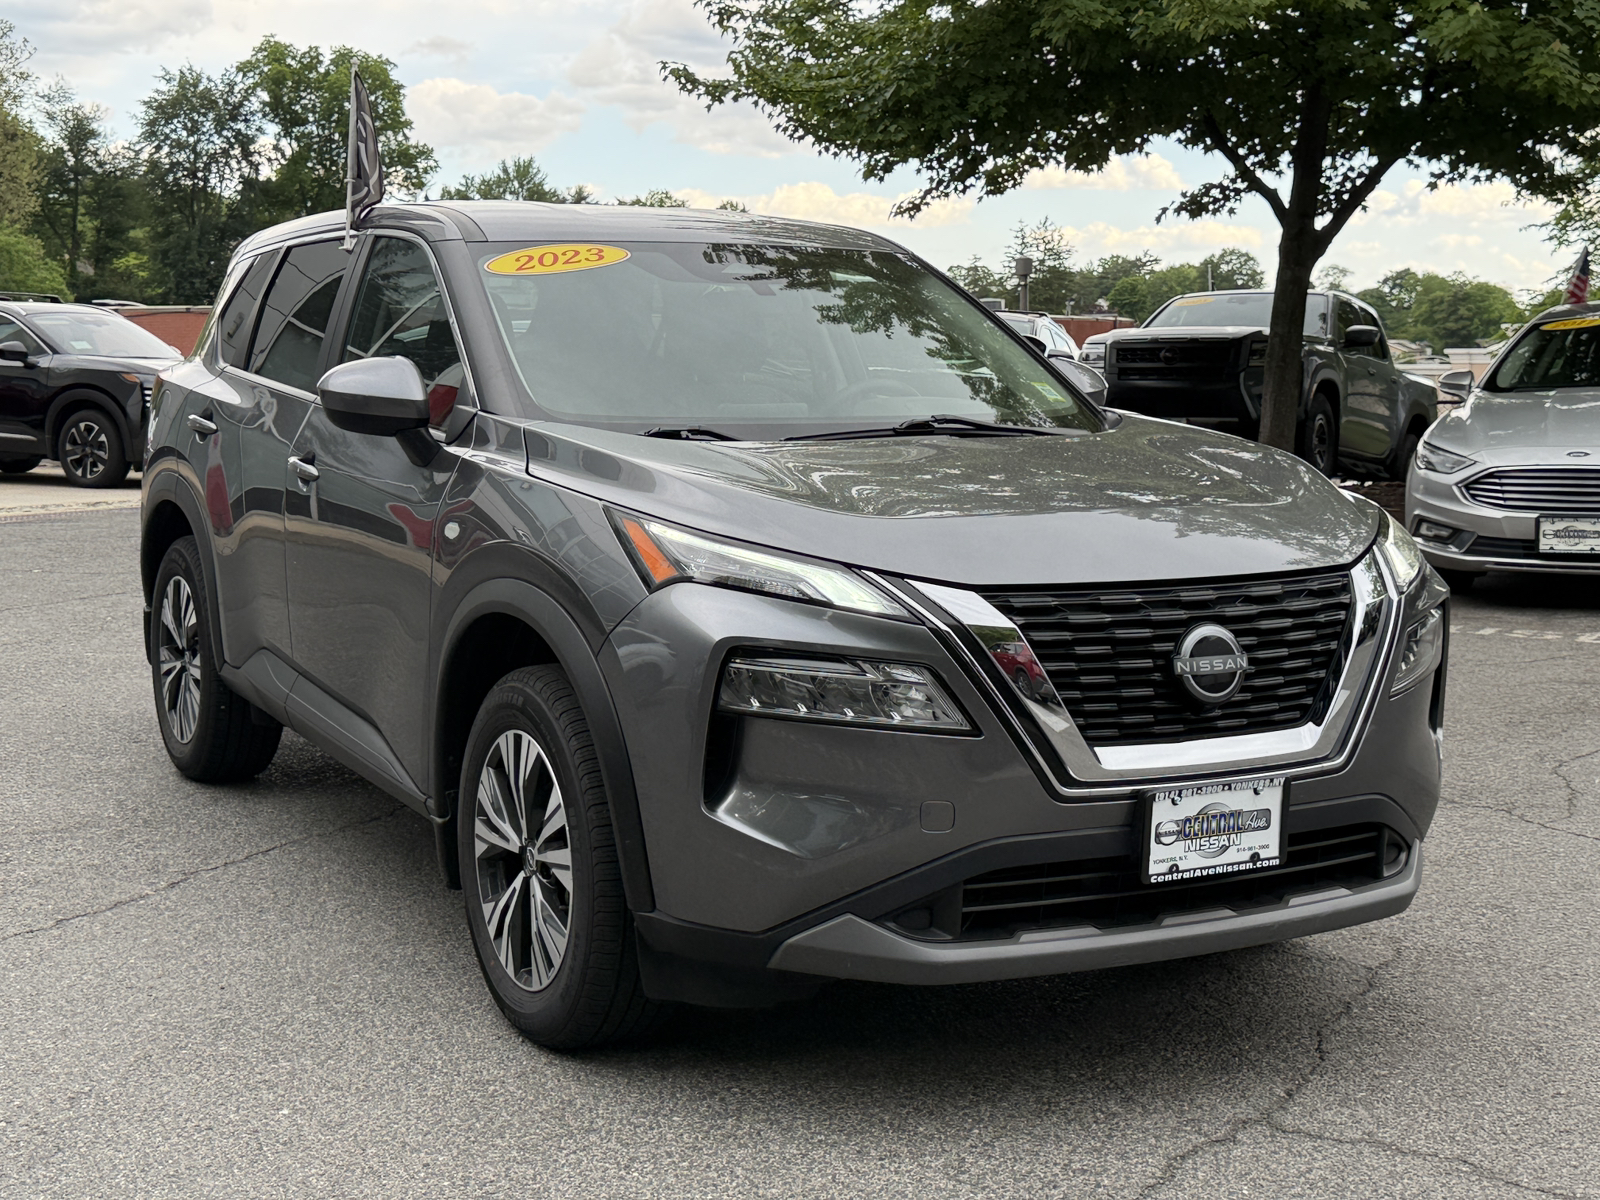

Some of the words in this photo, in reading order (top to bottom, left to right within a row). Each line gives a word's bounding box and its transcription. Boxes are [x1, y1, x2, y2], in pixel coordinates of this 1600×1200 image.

[514, 247, 605, 272] 2023
[1176, 656, 1247, 673] NISSAN
[1182, 809, 1243, 839] CENTRAL
[1244, 811, 1267, 830] Ave.
[1184, 833, 1242, 853] NISSAN
[1150, 858, 1280, 884] CentralAveNissan.com
